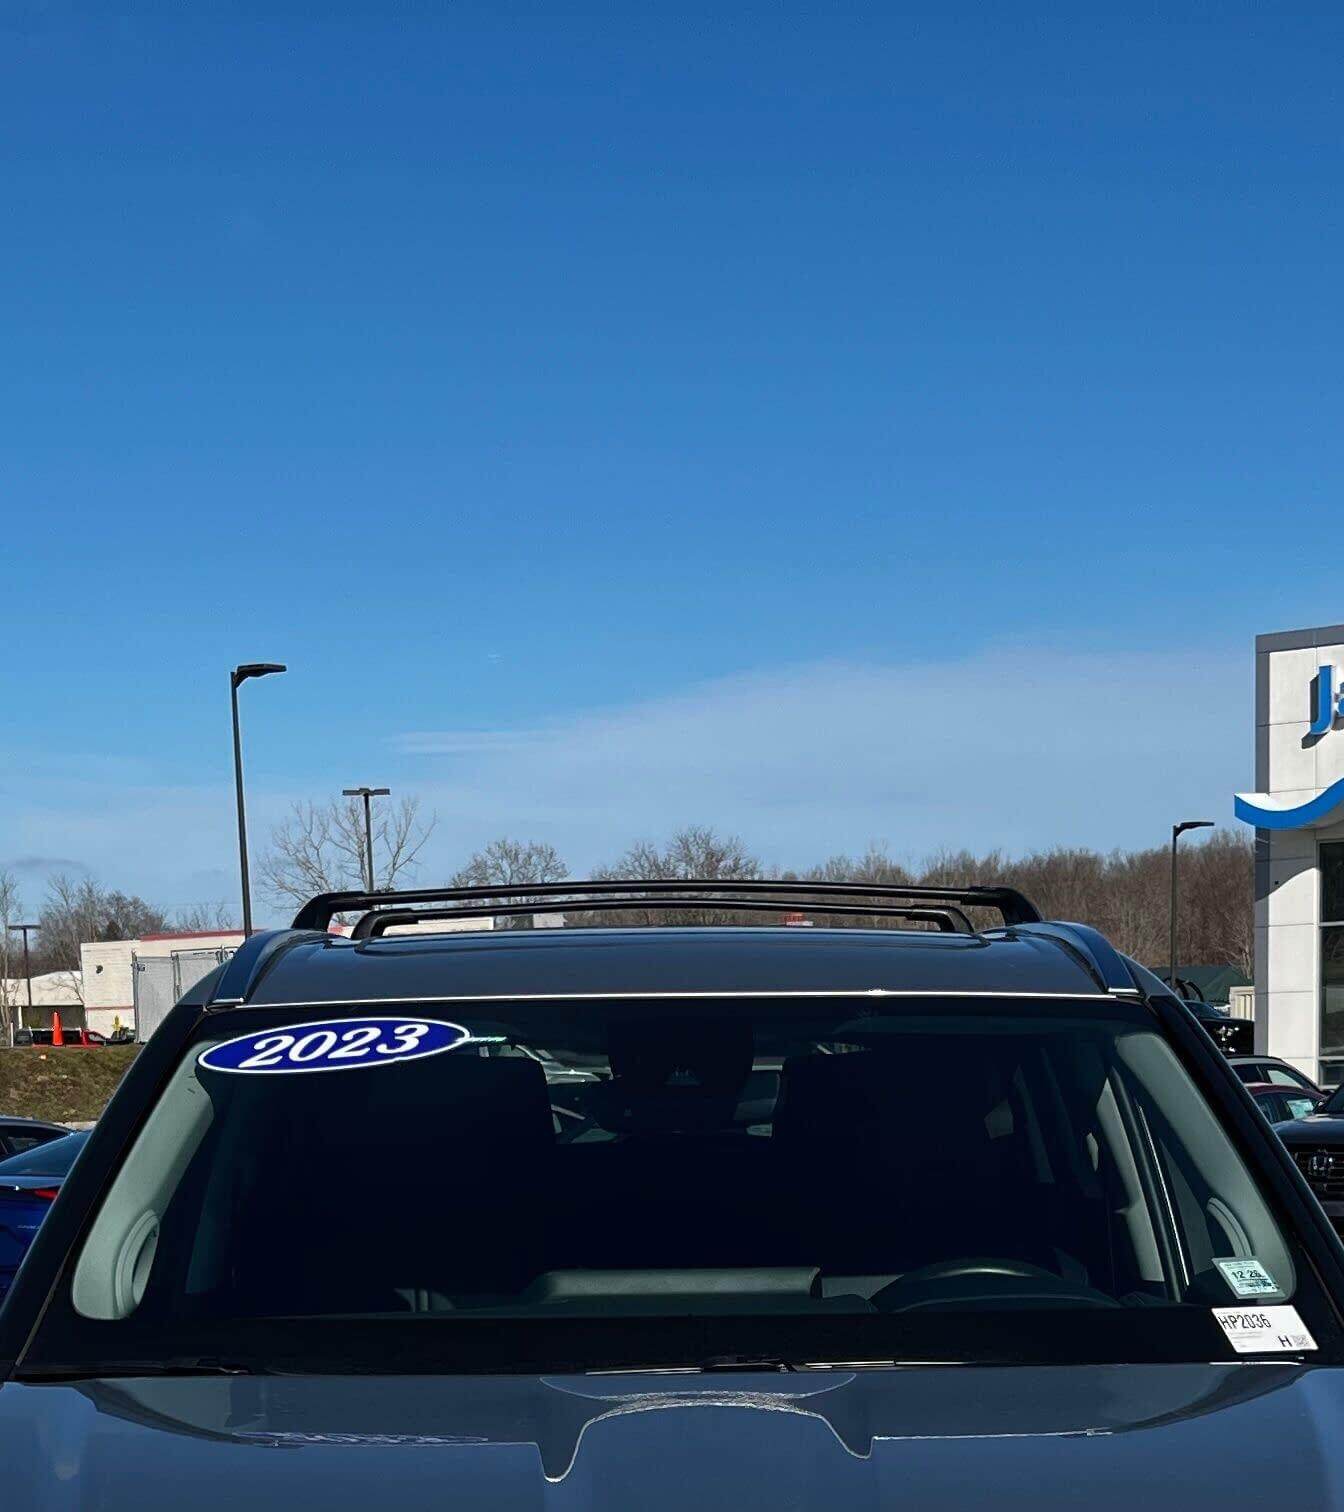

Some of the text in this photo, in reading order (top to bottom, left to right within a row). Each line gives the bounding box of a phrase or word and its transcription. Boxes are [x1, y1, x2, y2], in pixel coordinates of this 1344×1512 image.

[237, 1024, 429, 1068] 2023
[1218, 1314, 1271, 1329] HP2036
[1278, 1335, 1292, 1347] H
